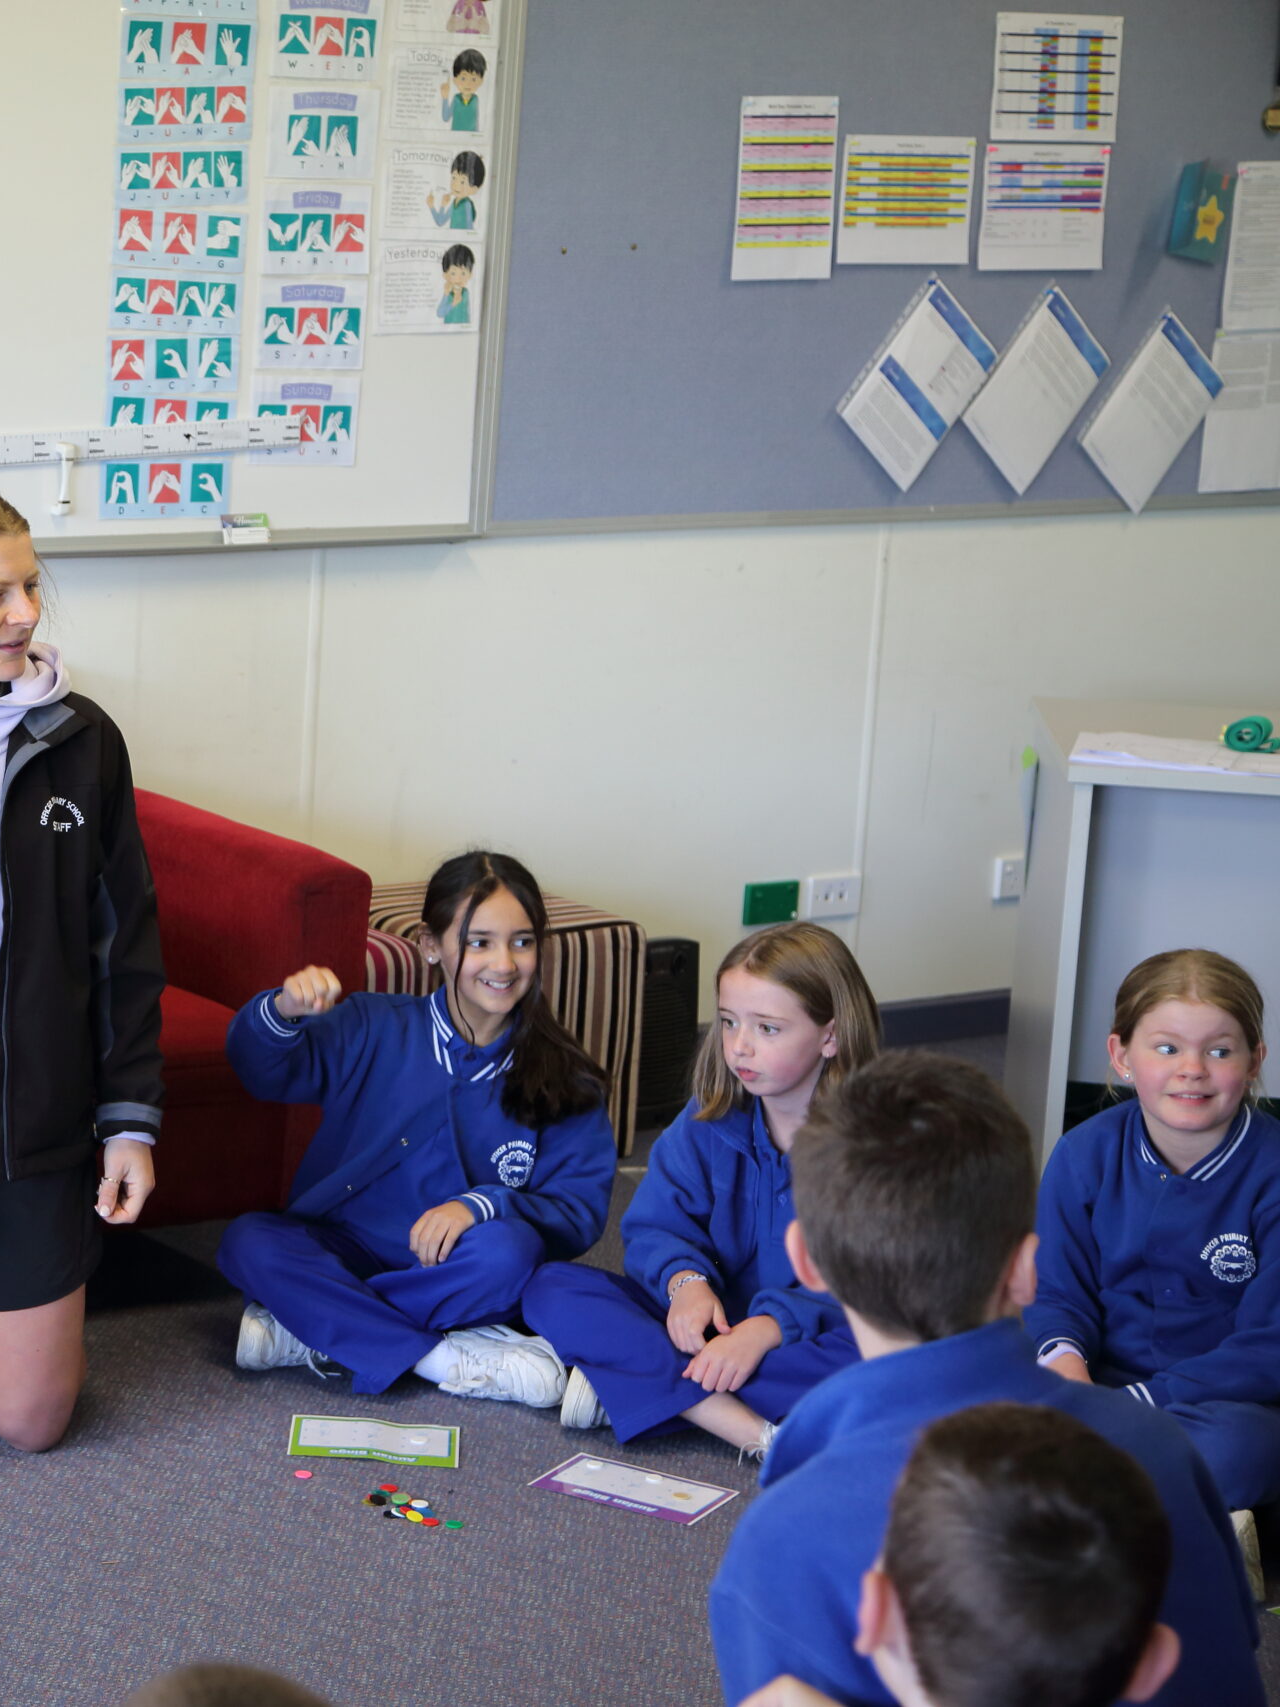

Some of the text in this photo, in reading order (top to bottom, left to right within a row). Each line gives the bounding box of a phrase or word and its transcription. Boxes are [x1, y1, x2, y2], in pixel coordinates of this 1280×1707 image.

[412, 51, 444, 65] Today
[300, 95, 352, 106] Thursday
[397, 151, 450, 163] Tomorrow
[298, 194, 337, 204] Friday
[387, 249, 442, 261] Yesterday
[286, 286, 342, 300] Saturday
[284, 385, 331, 399] Sunday
[66, 801, 84, 826] SCHOOL
[1200, 1233, 1248, 1260] OFFICER PRIMARY
